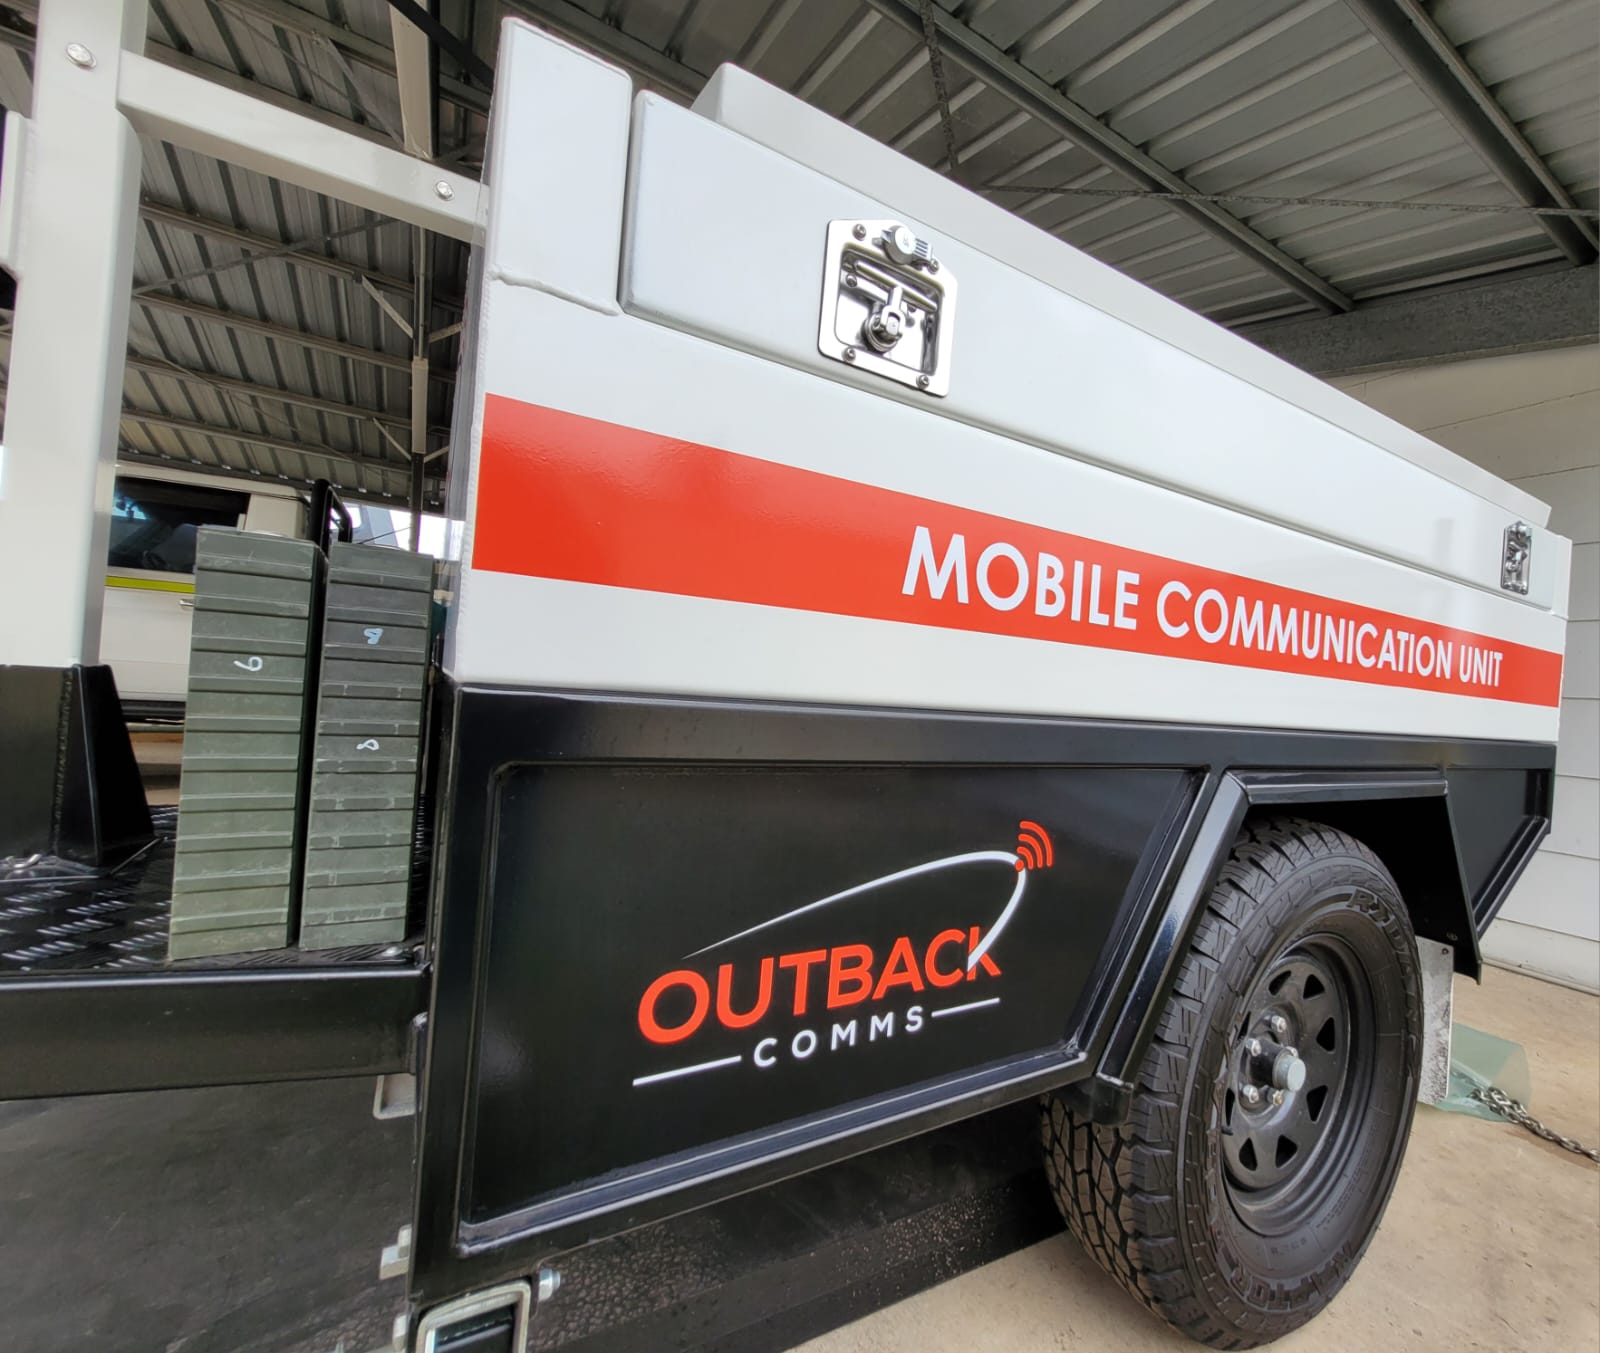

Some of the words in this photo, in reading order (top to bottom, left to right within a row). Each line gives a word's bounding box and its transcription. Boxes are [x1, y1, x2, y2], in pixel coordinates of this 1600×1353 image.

[902, 525, 1141, 630] MOBILE
[1156, 580, 1454, 679] COMMUNICATION
[1459, 643, 1503, 688] UNIT
[637, 926, 1002, 1044] OUTBACK
[753, 1005, 924, 1068] COMMS
